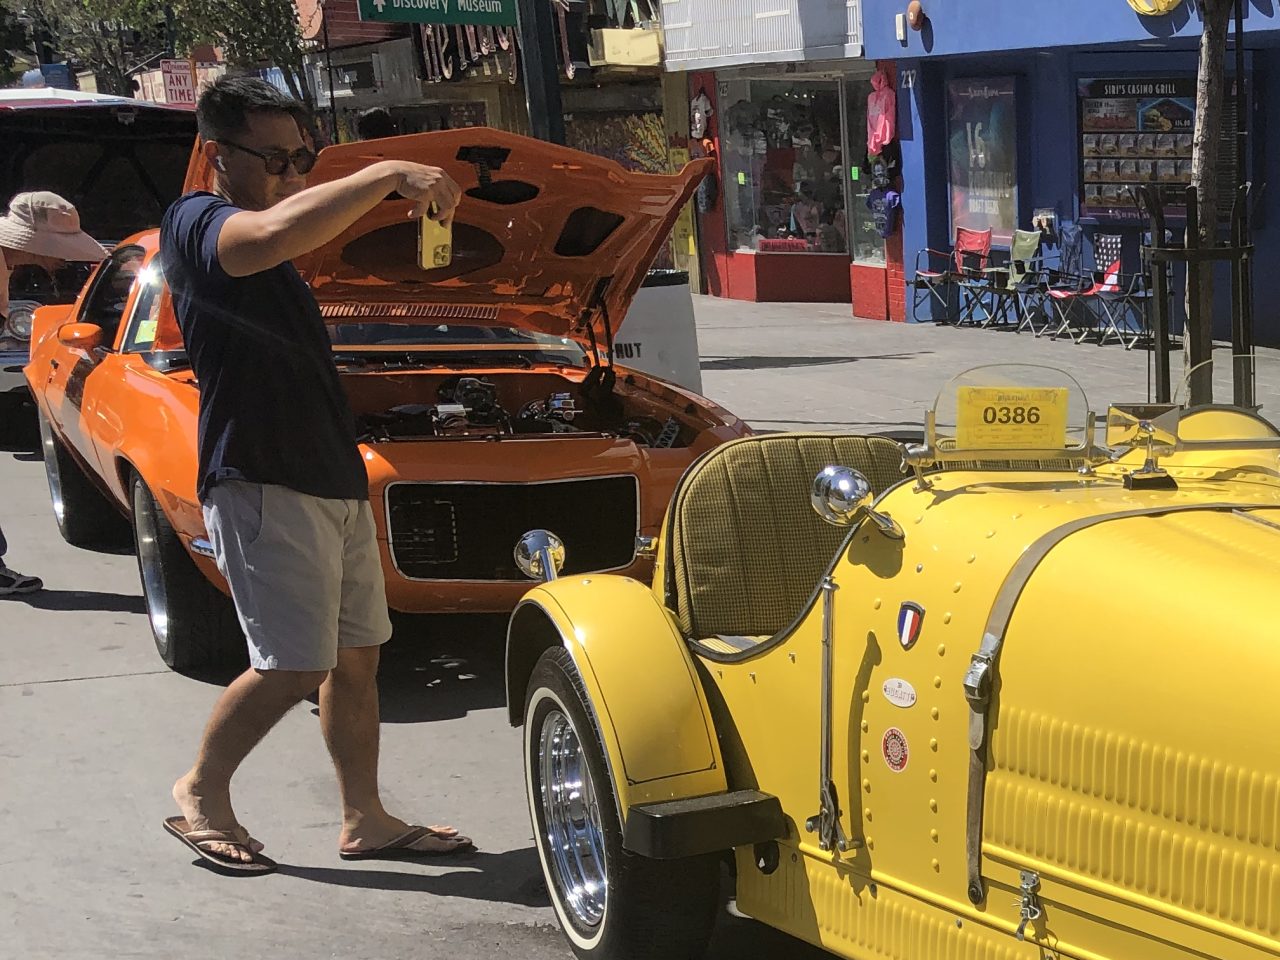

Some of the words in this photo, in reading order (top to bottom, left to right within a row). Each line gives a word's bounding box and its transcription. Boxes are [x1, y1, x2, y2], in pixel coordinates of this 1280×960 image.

[394, 0, 448, 14] Discovery
[458, 0, 502, 13] Museum
[169, 75, 187, 87] ANY
[901, 70, 917, 88] 237
[169, 89, 192, 101] TIME
[1104, 84, 1126, 95] SIRI'S
[1128, 84, 1153, 95] CASINO
[1156, 83, 1176, 95] GRILL
[983, 406, 1041, 424] 0386
